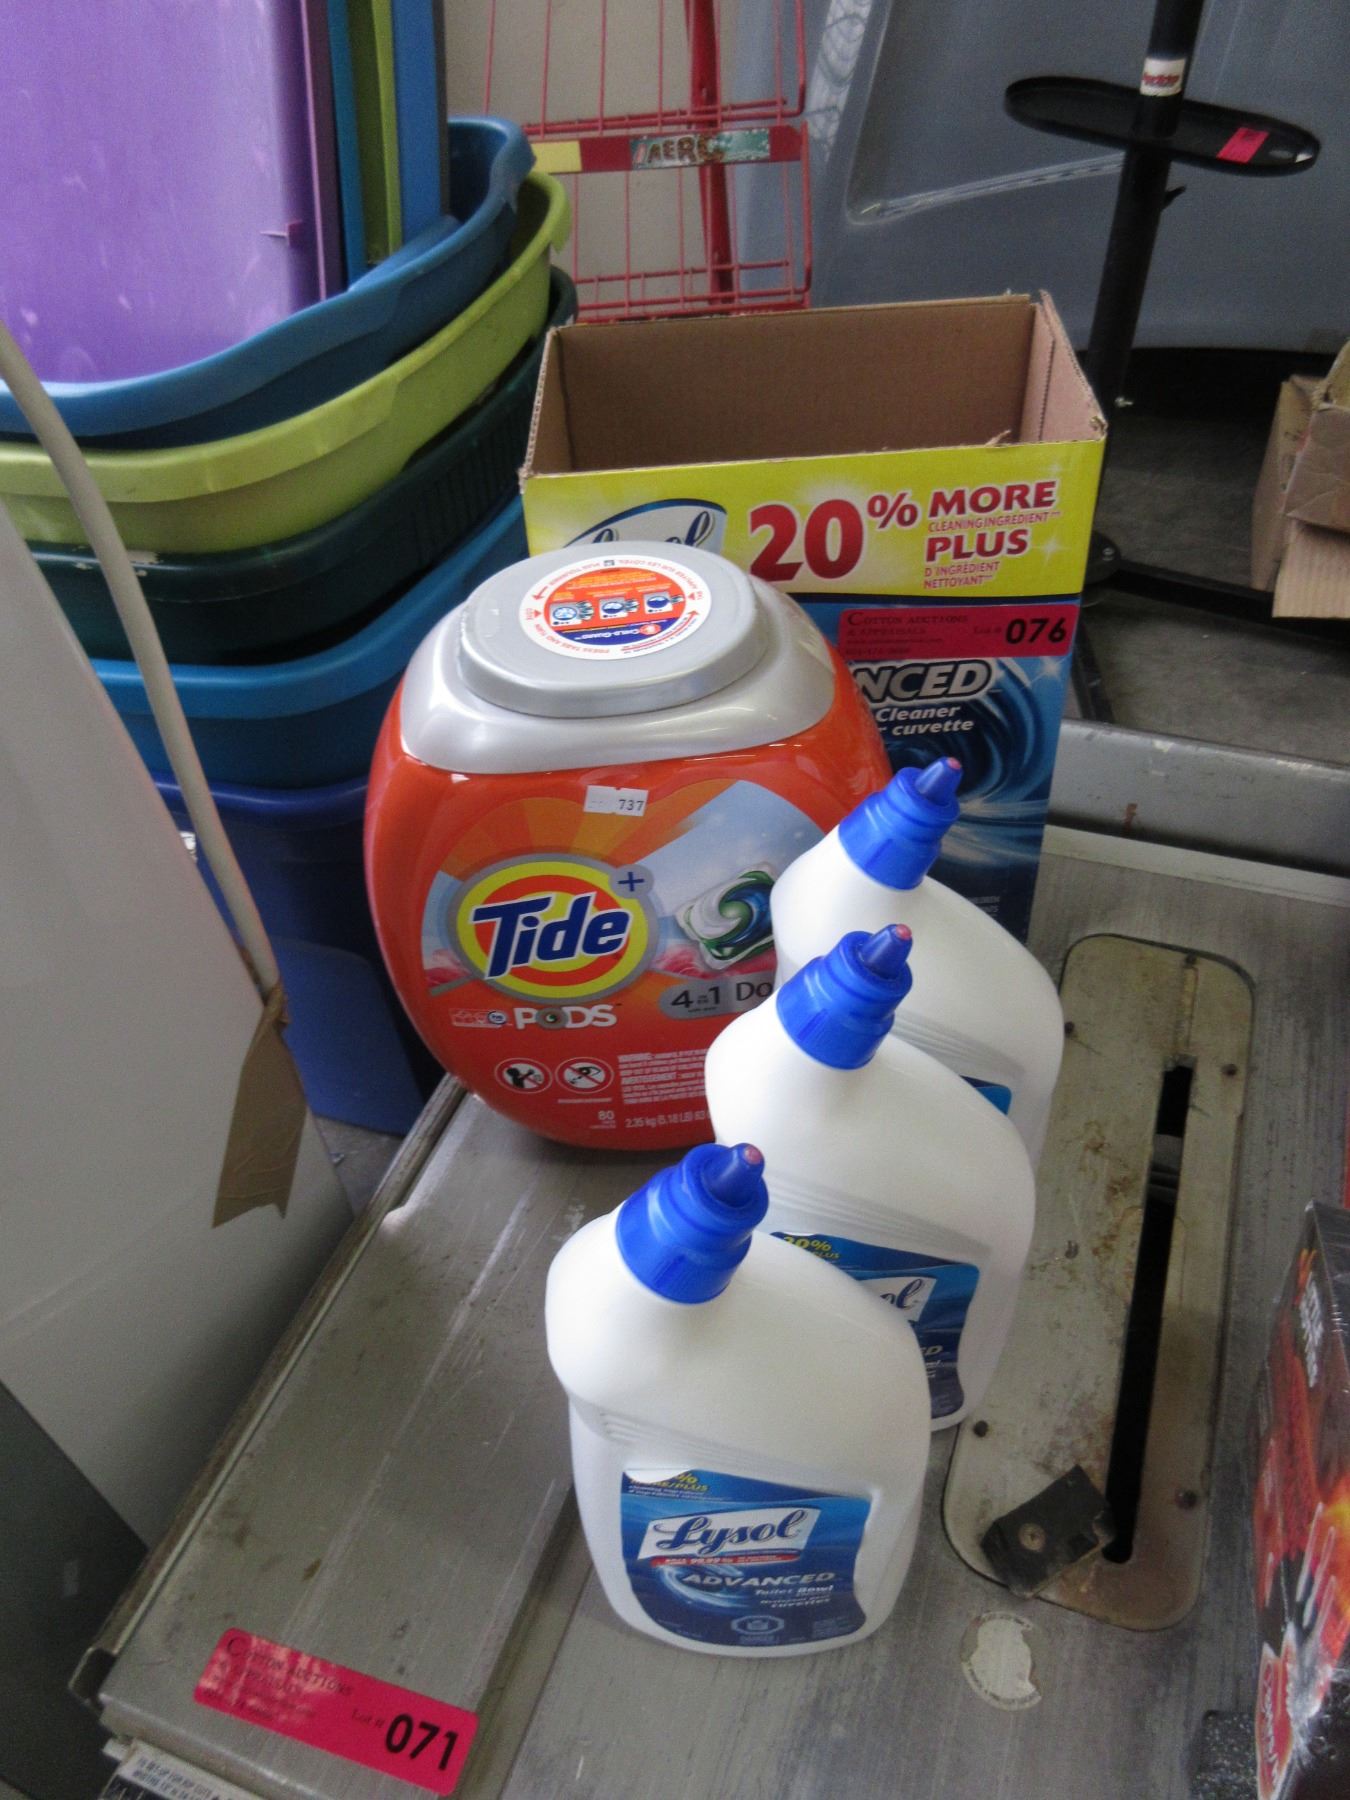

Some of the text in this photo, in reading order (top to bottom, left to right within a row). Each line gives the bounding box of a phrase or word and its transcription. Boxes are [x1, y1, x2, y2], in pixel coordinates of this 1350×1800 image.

[928, 480, 1057, 518] MORE
[749, 492, 917, 582] 20%
[928, 517, 984, 532] CLEANING
[925, 529, 1029, 563] PLUS
[1005, 618, 1068, 645] 076
[853, 660, 993, 701] NCED
[875, 705, 961, 722] Cleaner
[892, 719, 974, 736] cuvette
[618, 798, 645, 812] 737
[470, 892, 633, 979] Tide
[736, 981, 774, 1002] Do
[652, 1508, 808, 1556] Lysol
[682, 1572, 836, 1587] ADVANCED
[385, 1712, 460, 1772] 071
